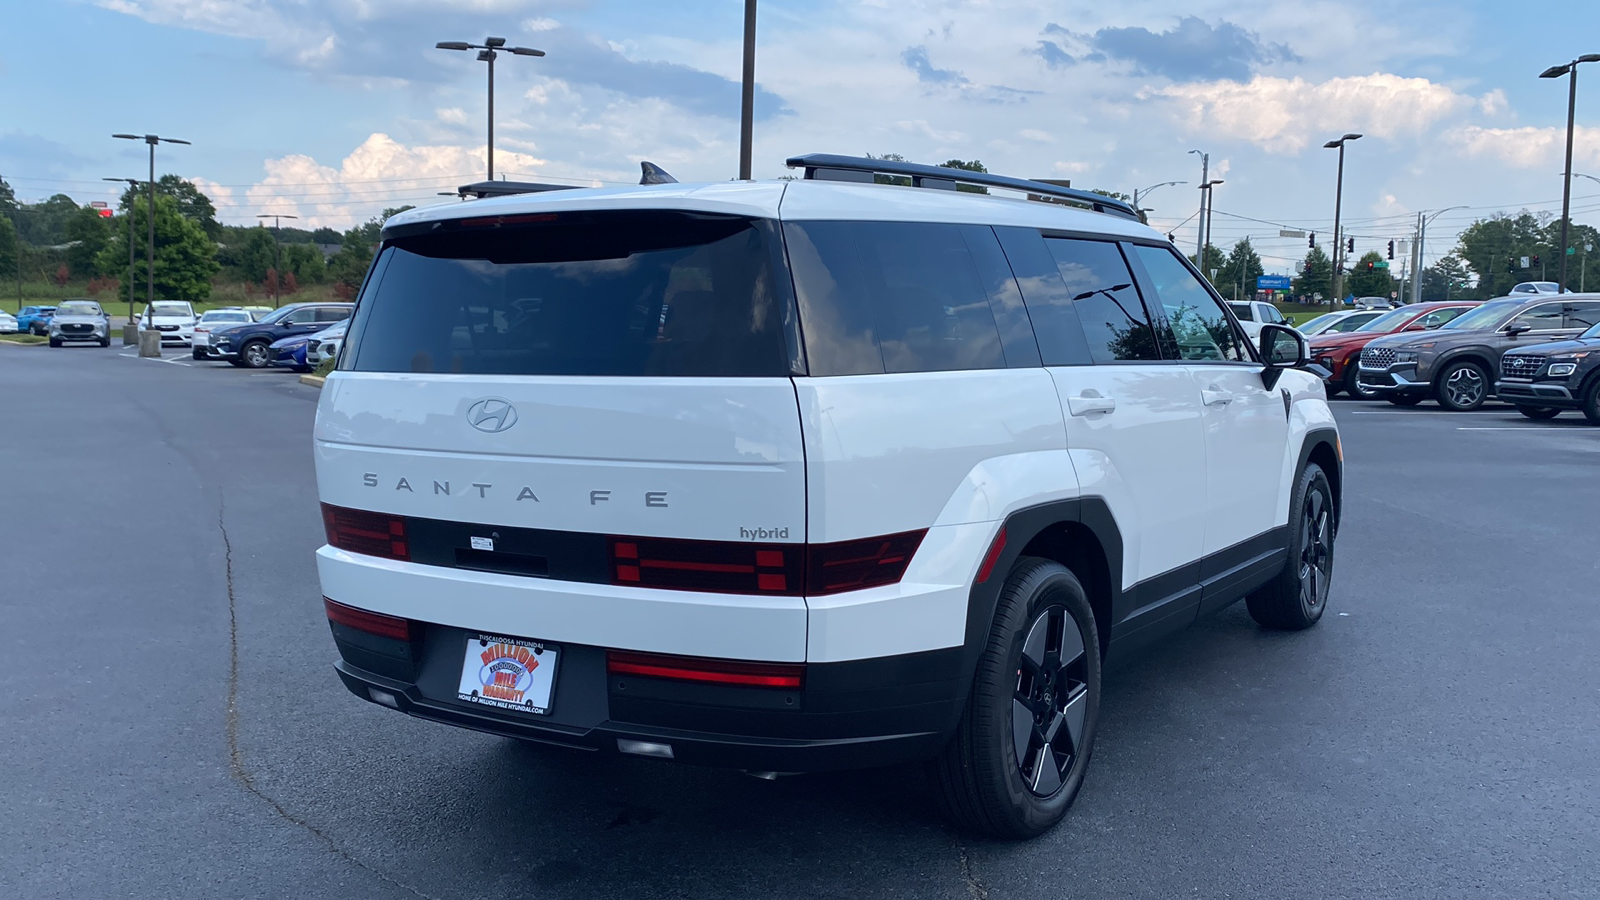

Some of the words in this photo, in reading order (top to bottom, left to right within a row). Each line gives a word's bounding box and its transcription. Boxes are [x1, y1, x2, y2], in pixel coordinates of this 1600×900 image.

[363, 472, 540, 503] SANTA
[590, 489, 669, 508] FE
[739, 525, 790, 541] hybrid
[479, 634, 515, 645] TUSCALOOSA
[516, 640, 544, 649] HYUNDAI
[480, 643, 540, 674] MILLION
[494, 671, 517, 688] MILE
[458, 694, 472, 702] HOME
[478, 697, 497, 707] MILLION
[497, 700, 508, 709] MILE
[508, 702, 544, 715] HYUNDAI.COM
